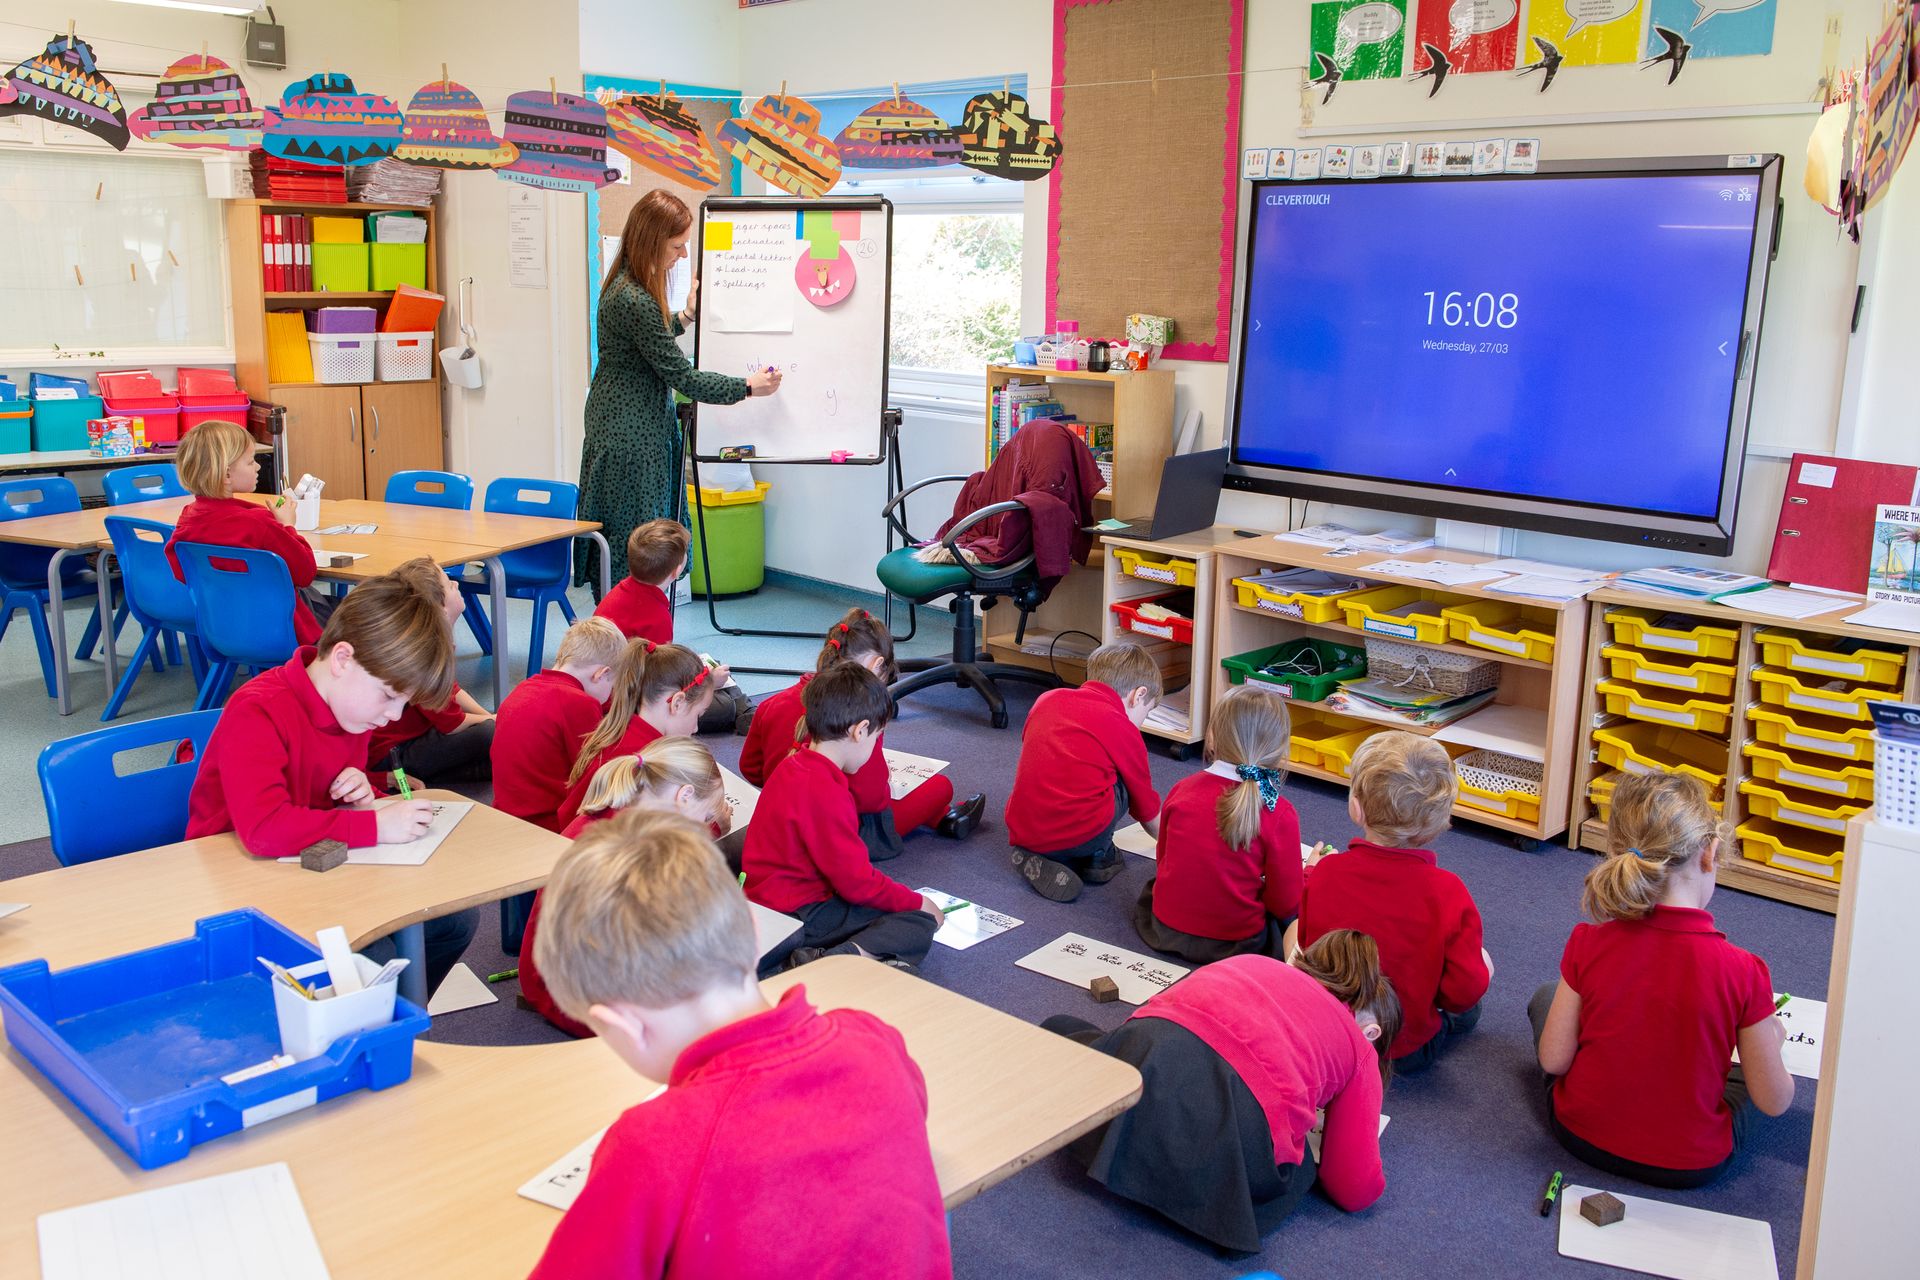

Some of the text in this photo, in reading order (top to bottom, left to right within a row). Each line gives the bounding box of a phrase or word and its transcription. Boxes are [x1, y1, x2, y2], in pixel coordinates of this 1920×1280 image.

[1265, 194, 1331, 206] CLEVERTOUCH
[722, 280, 766, 289] Spellings
[1423, 291, 1519, 329] 16:08
[1422, 340, 1509, 354] Wednesday, 27/03
[1884, 509, 1920, 523] WHERE TH
[1874, 591, 1890, 600] STORY
[1891, 593, 1902, 602] AND
